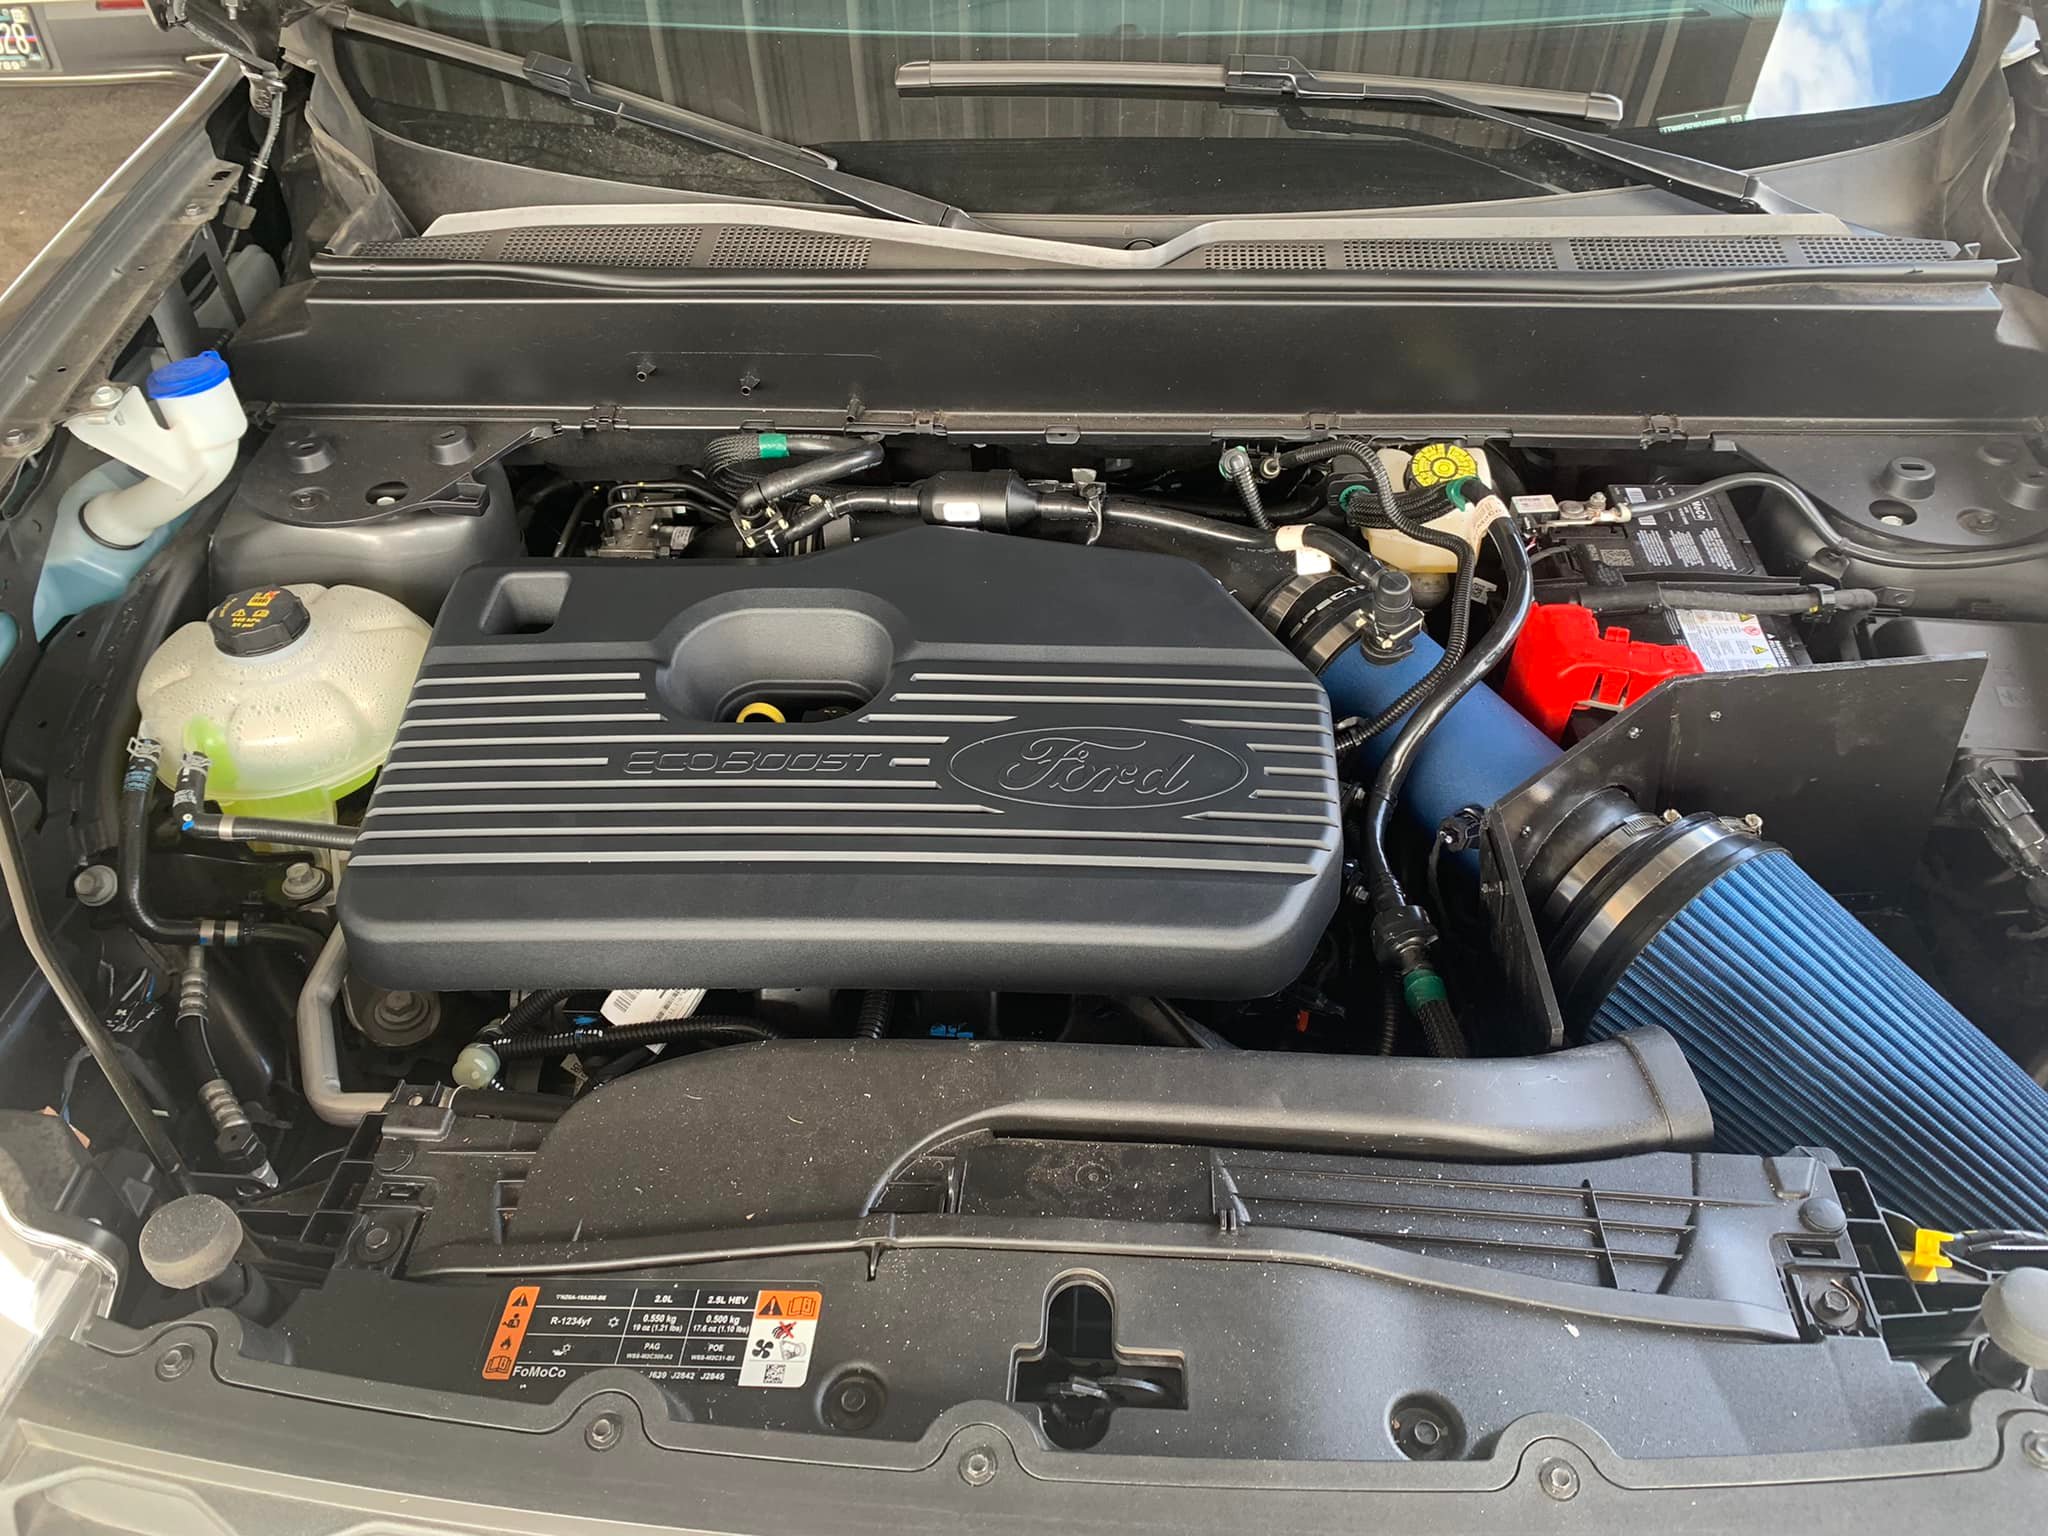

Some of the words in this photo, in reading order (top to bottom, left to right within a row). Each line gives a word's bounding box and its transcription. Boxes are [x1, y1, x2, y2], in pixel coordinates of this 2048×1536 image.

[999, 737, 1195, 796] Ford
[654, 1295, 673, 1304] 2.0L
[707, 1296, 727, 1304] 2.5L
[728, 1296, 748, 1305] HEV
[550, 1316, 592, 1327] R-1234yf
[643, 1314, 666, 1323] 0.550
[667, 1315, 677, 1326] kg
[706, 1315, 729, 1324] 0.500
[730, 1316, 740, 1326] kg
[671, 1324, 683, 1333] lbs)
[644, 1343, 661, 1351] PAG
[708, 1344, 725, 1352] POE
[512, 1366, 567, 1378] FoMoCo
